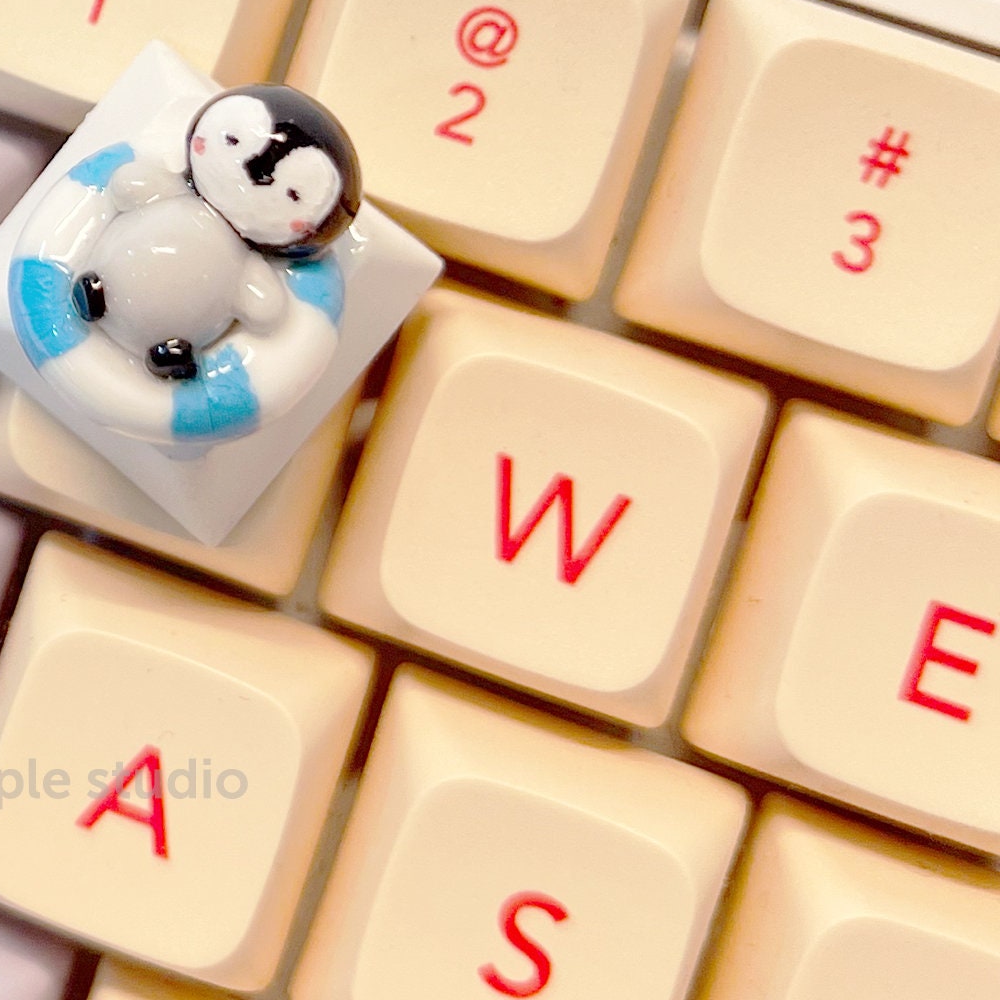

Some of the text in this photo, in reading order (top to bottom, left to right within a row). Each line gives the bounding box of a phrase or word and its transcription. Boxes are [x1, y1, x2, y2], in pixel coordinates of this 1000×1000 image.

[456, 5, 520, 70] @
[434, 83, 488, 146] 2
[858, 125, 912, 189] #
[832, 210, 882, 275] 3
[494, 451, 633, 587] W
[898, 600, 998, 723] E
[75, 744, 172, 862] A
[477, 889, 570, 1000] S
